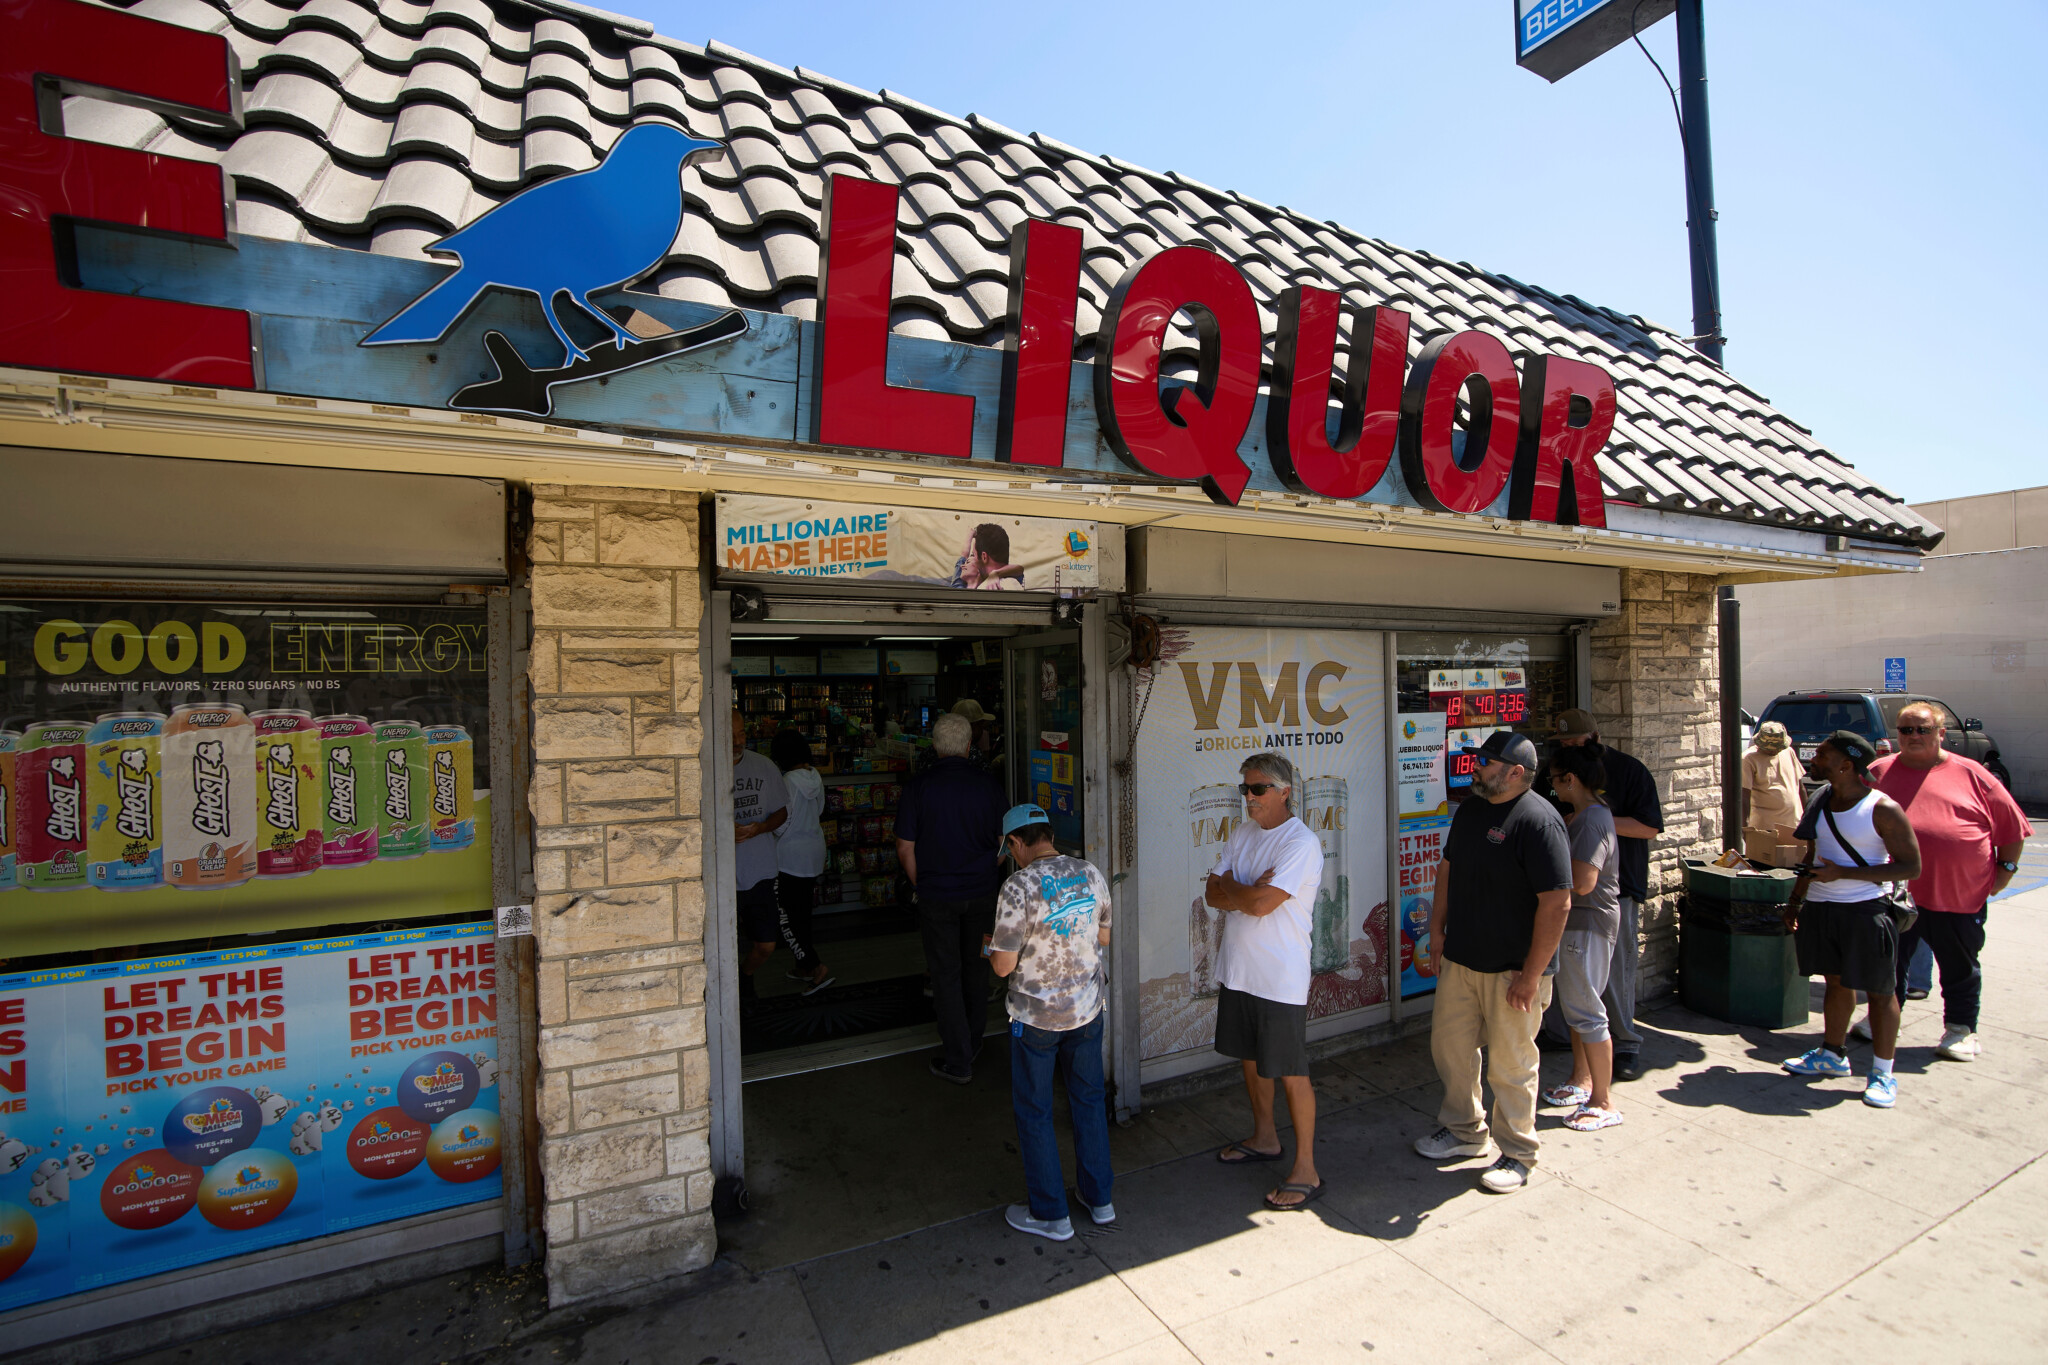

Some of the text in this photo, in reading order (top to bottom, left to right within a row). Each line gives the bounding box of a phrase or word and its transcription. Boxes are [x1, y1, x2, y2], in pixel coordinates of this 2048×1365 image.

[818, 173, 1618, 528] LIQUOR
[727, 513, 888, 546] MILLIONAIRE
[727, 533, 888, 573] MADE HERE
[819, 561, 863, 576] NEXT?
[33, 618, 489, 676] GOOD ENERGY
[61, 680, 341, 693] AUTHENTIC FLAVORS ZERO SUGARS NO BS
[1177, 660, 1349, 731] VMC
[1475, 695, 1494, 714] 40
[1499, 694, 1525, 713] 336
[189, 713, 231, 725] ENERGY
[262, 718, 300, 730] ENERGY
[1471, 716, 1492, 724] MILLION
[1503, 712, 1523, 723] MILLION
[41, 730, 84, 741] ENERGY
[112, 722, 155, 734] ENERGY
[324, 723, 358, 734] ENERGY
[381, 728, 412, 738] ENERGY
[431, 732, 459, 741] ENERGY
[1195, 738, 1204, 752] EL
[1203, 731, 1345, 752] ORIGEN ANTE TODO
[1422, 744, 1444, 752] LIQUOR
[433, 760, 457, 817] GHOST
[1453, 776, 1473, 784] THOUSA
[192, 755, 230, 838] GHOST
[265, 757, 299, 832] GHOST
[328, 758, 358, 826] GHOST
[384, 760, 411, 821] GHOST
[46, 769, 82, 843] GHOST
[116, 763, 154, 841] GHOST
[735, 807, 763, 820] AMAS
[1415, 833, 1441, 849] THE
[198, 858, 227, 867] ORANGE
[1322, 852, 1339, 860] ARITA
[1400, 848, 1442, 867] REAMS
[1400, 864, 1440, 888] EGIN
[1404, 885, 1422, 897] YOUR
[478, 924, 494, 933] TOD
[327, 940, 355, 950] TODAY
[781, 926, 806, 961] JEANS
[153, 958, 187, 969] TODAY
[221, 951, 245, 961] LET'S
[349, 943, 495, 981] LET THE
[31, 969, 58, 983] LET'S
[104, 966, 284, 1011] LET THE
[349, 968, 496, 1008] DREAMS
[105, 995, 285, 1041] DREAMS
[350, 993, 498, 1042] BEGIN
[106, 1022, 286, 1079] BEGIN
[352, 1026, 498, 1058] PICK YOUR GAME
[106, 1057, 287, 1097] PICK YOUR GAME
[433, 1073, 463, 1086] MEGA
[204, 1111, 242, 1127] MEGA
[356, 1130, 411, 1148] POWER
[112, 1173, 179, 1196] POWER
